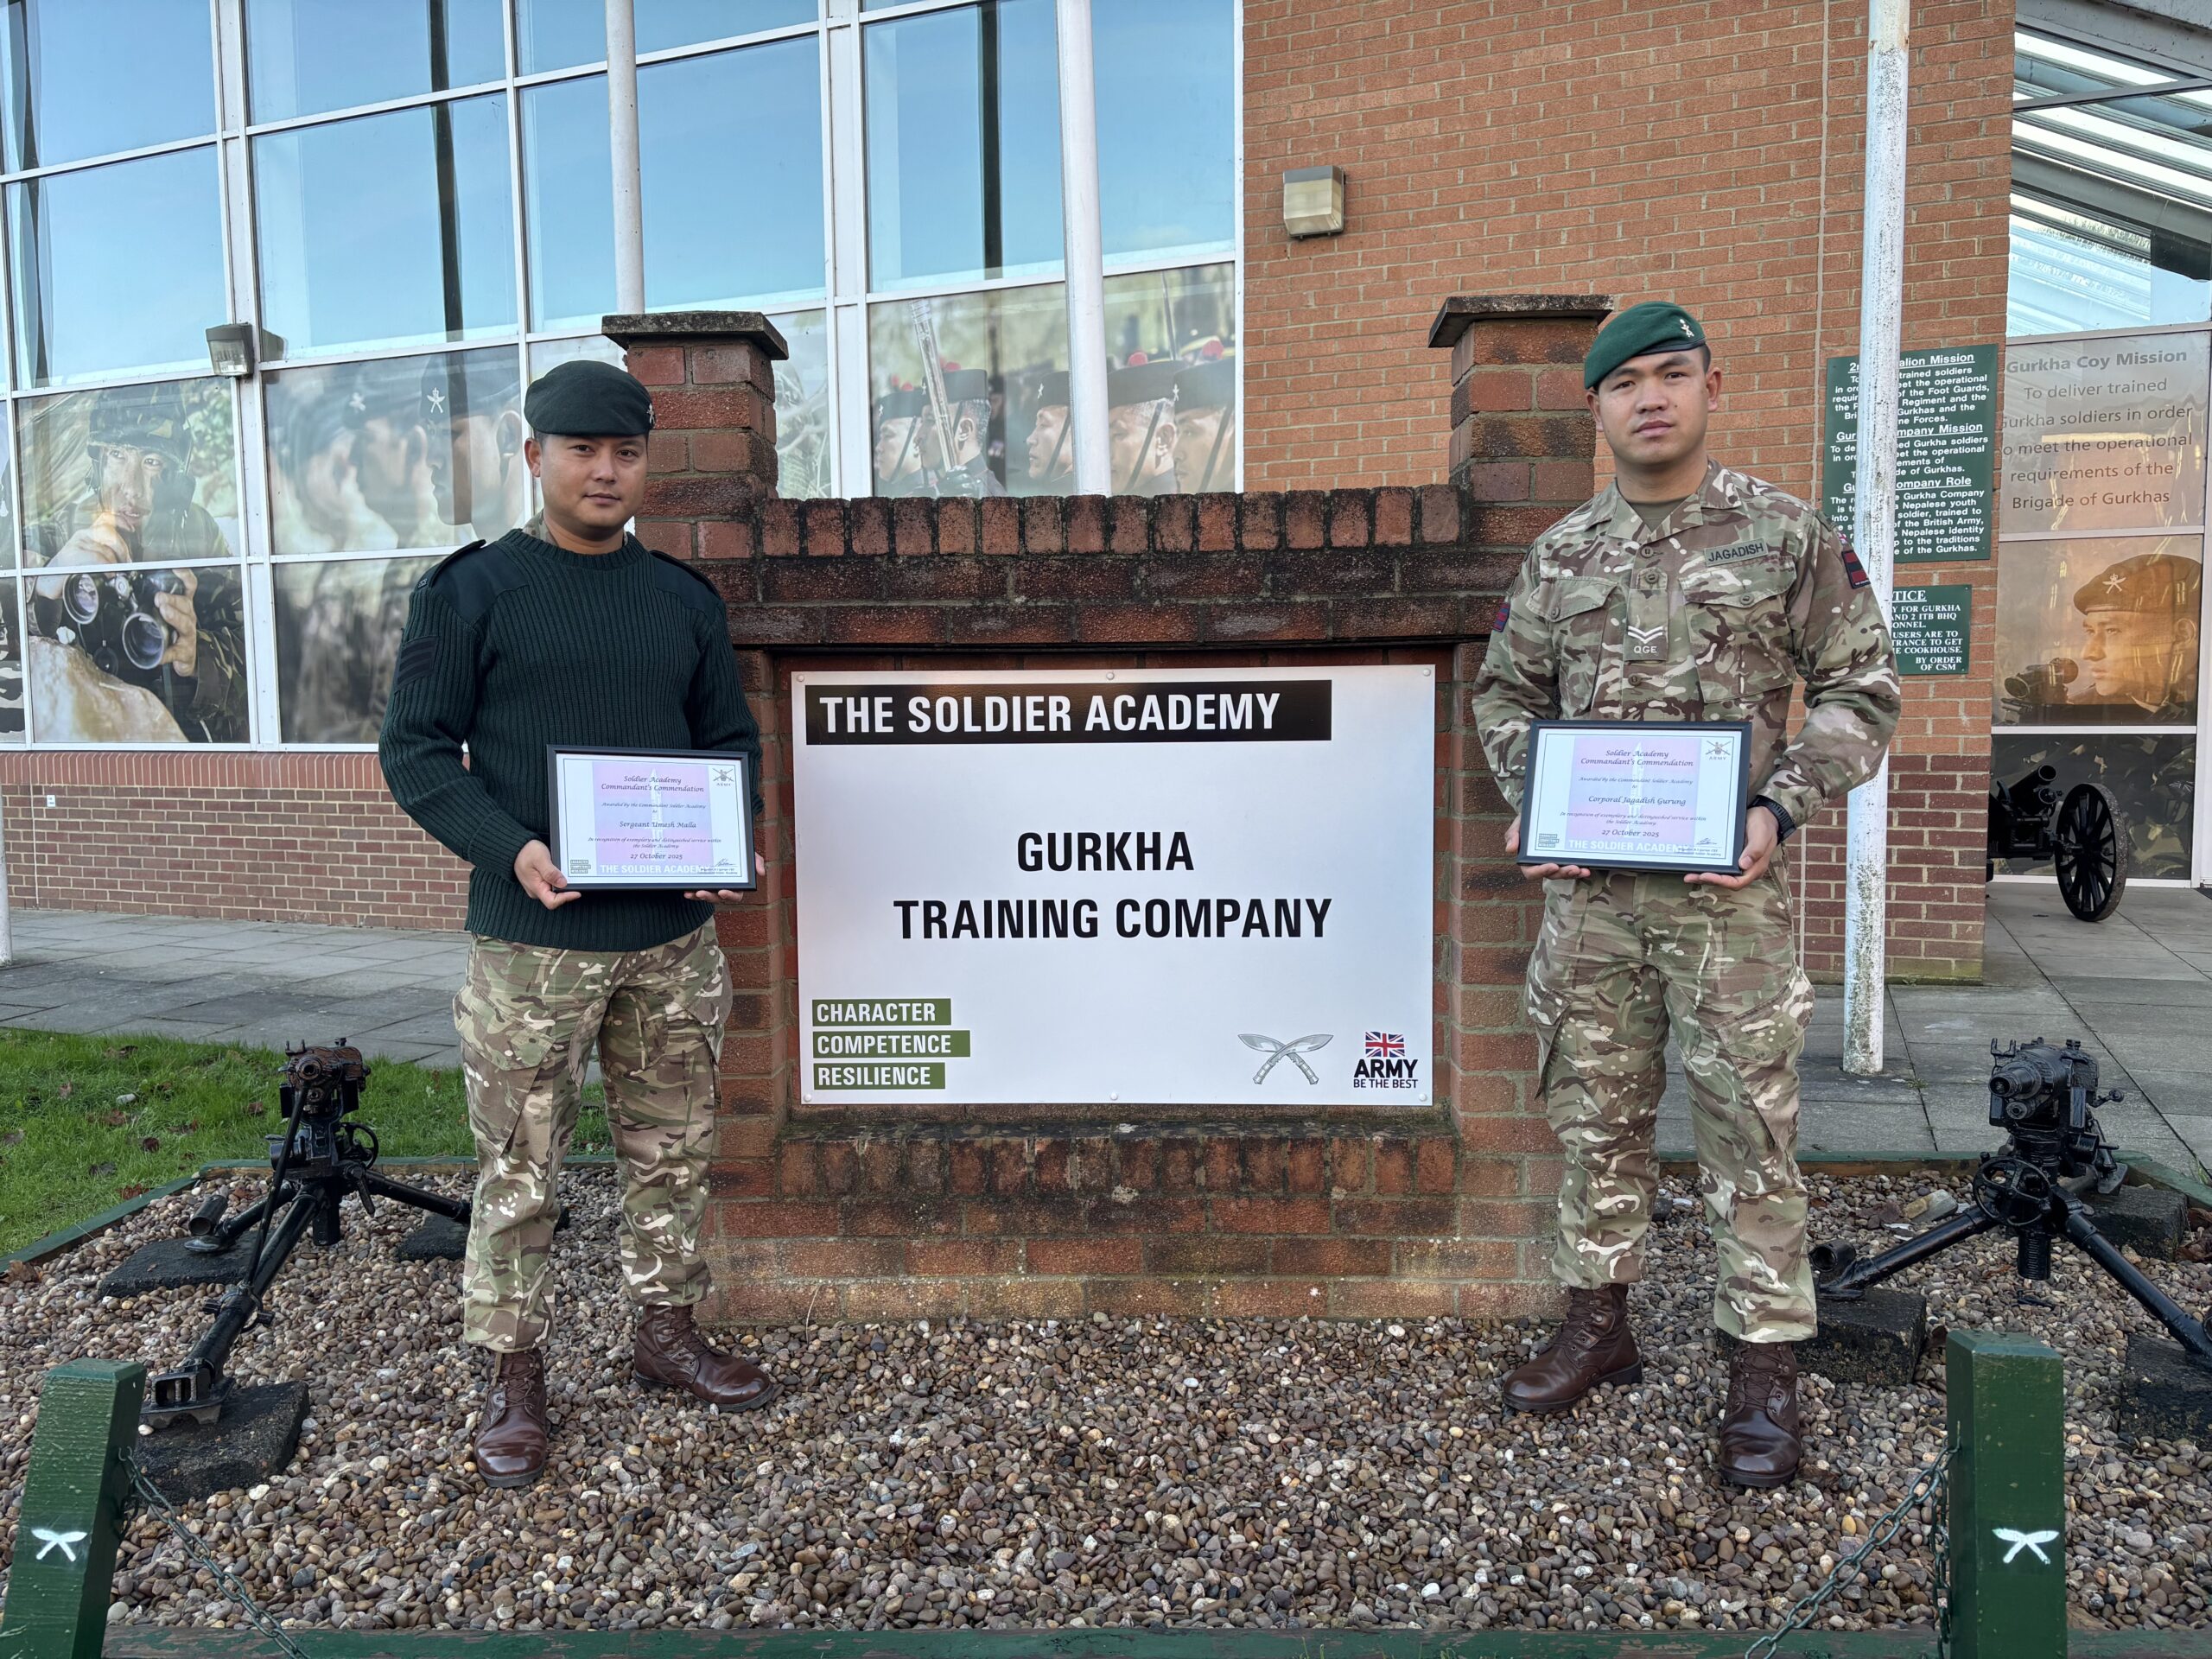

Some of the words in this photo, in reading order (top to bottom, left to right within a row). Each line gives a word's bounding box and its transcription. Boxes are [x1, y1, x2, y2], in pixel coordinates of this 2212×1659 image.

[1898, 358, 1925, 366] alion
[1930, 353, 1974, 364] Mission
[2006, 358, 2070, 373] Gurkha
[2076, 355, 2110, 370] Coy
[2117, 350, 2187, 366] Mission
[1899, 370, 1931, 378] trained
[1935, 367, 1973, 376] soldiers
[1935, 374, 1987, 386] operational
[1833, 394, 1859, 404] requir
[1928, 386, 1949, 395] Foot
[1953, 385, 1990, 394] Guards,
[2024, 387, 2042, 400] To
[2048, 383, 2102, 398] deliver
[2107, 378, 2167, 394] trained
[1902, 397, 1946, 407] Regiment
[1897, 407, 1935, 416] Gurkhas
[2060, 410, 2121, 425] soldiers
[2126, 408, 2141, 421] in
[2147, 405, 2193, 419] order
[1836, 432, 1856, 441] Gur
[1897, 427, 1934, 437] mpany
[1939, 423, 1983, 433] Mission
[1914, 439, 1947, 448] Gurkha
[1951, 436, 1988, 445] soldiers
[2018, 442, 2059, 454] meet
[2064, 439, 2091, 451] the
[2096, 433, 2192, 452] operational
[1932, 445, 1985, 456] operational
[1897, 458, 1930, 467] ements
[2011, 465, 2119, 484] requirements
[2124, 463, 2141, 476] of
[2145, 461, 2174, 474] the
[1897, 480, 1941, 489] ompany
[1946, 476, 1971, 486] Role
[1904, 492, 1936, 500] Gurkha
[2012, 494, 2074, 511] Brigade
[2079, 492, 2097, 505] of
[2102, 490, 2171, 504] Gurkhas
[1903, 500, 1946, 510] Nepalese
[1950, 499, 1977, 507] youth
[1708, 543, 1764, 562] JAGADISH
[1936, 544, 1977, 553] Gurkhas.
[1892, 590, 1926, 601] TICE
[1922, 604, 1961, 613] GURKHA
[1634, 645, 1657, 654] QGE
[820, 696, 893, 733] THE
[908, 696, 1071, 733] SOLDIER
[1085, 692, 1281, 732] ACADEMY
[1632, 751, 1669, 760] Academy
[649, 776, 682, 785] Academy
[654, 784, 704, 792] Commendation
[1588, 796, 1622, 804] Corporal
[1622, 797, 1656, 805] Jagadish
[1657, 798, 1686, 806] Gurung
[1569, 839, 1588, 849] THE
[1590, 840, 1634, 851] SOLDIER
[1017, 831, 1194, 872] GURKHA
[600, 865, 619, 874] THE
[621, 865, 661, 874] SOLDIER
[893, 899, 1098, 940] TRAINING
[1116, 898, 1332, 939] COMPANY
[817, 1003, 936, 1022] CHARACTER
[817, 1035, 951, 1054] COMPETENCE
[1353, 1058, 1419, 1078] ARMY
[818, 1066, 931, 1086] RESILIENCE
[1353, 1079, 1366, 1088] BE
[1369, 1079, 1389, 1089] THE
[1393, 1079, 1419, 1089] BEST
